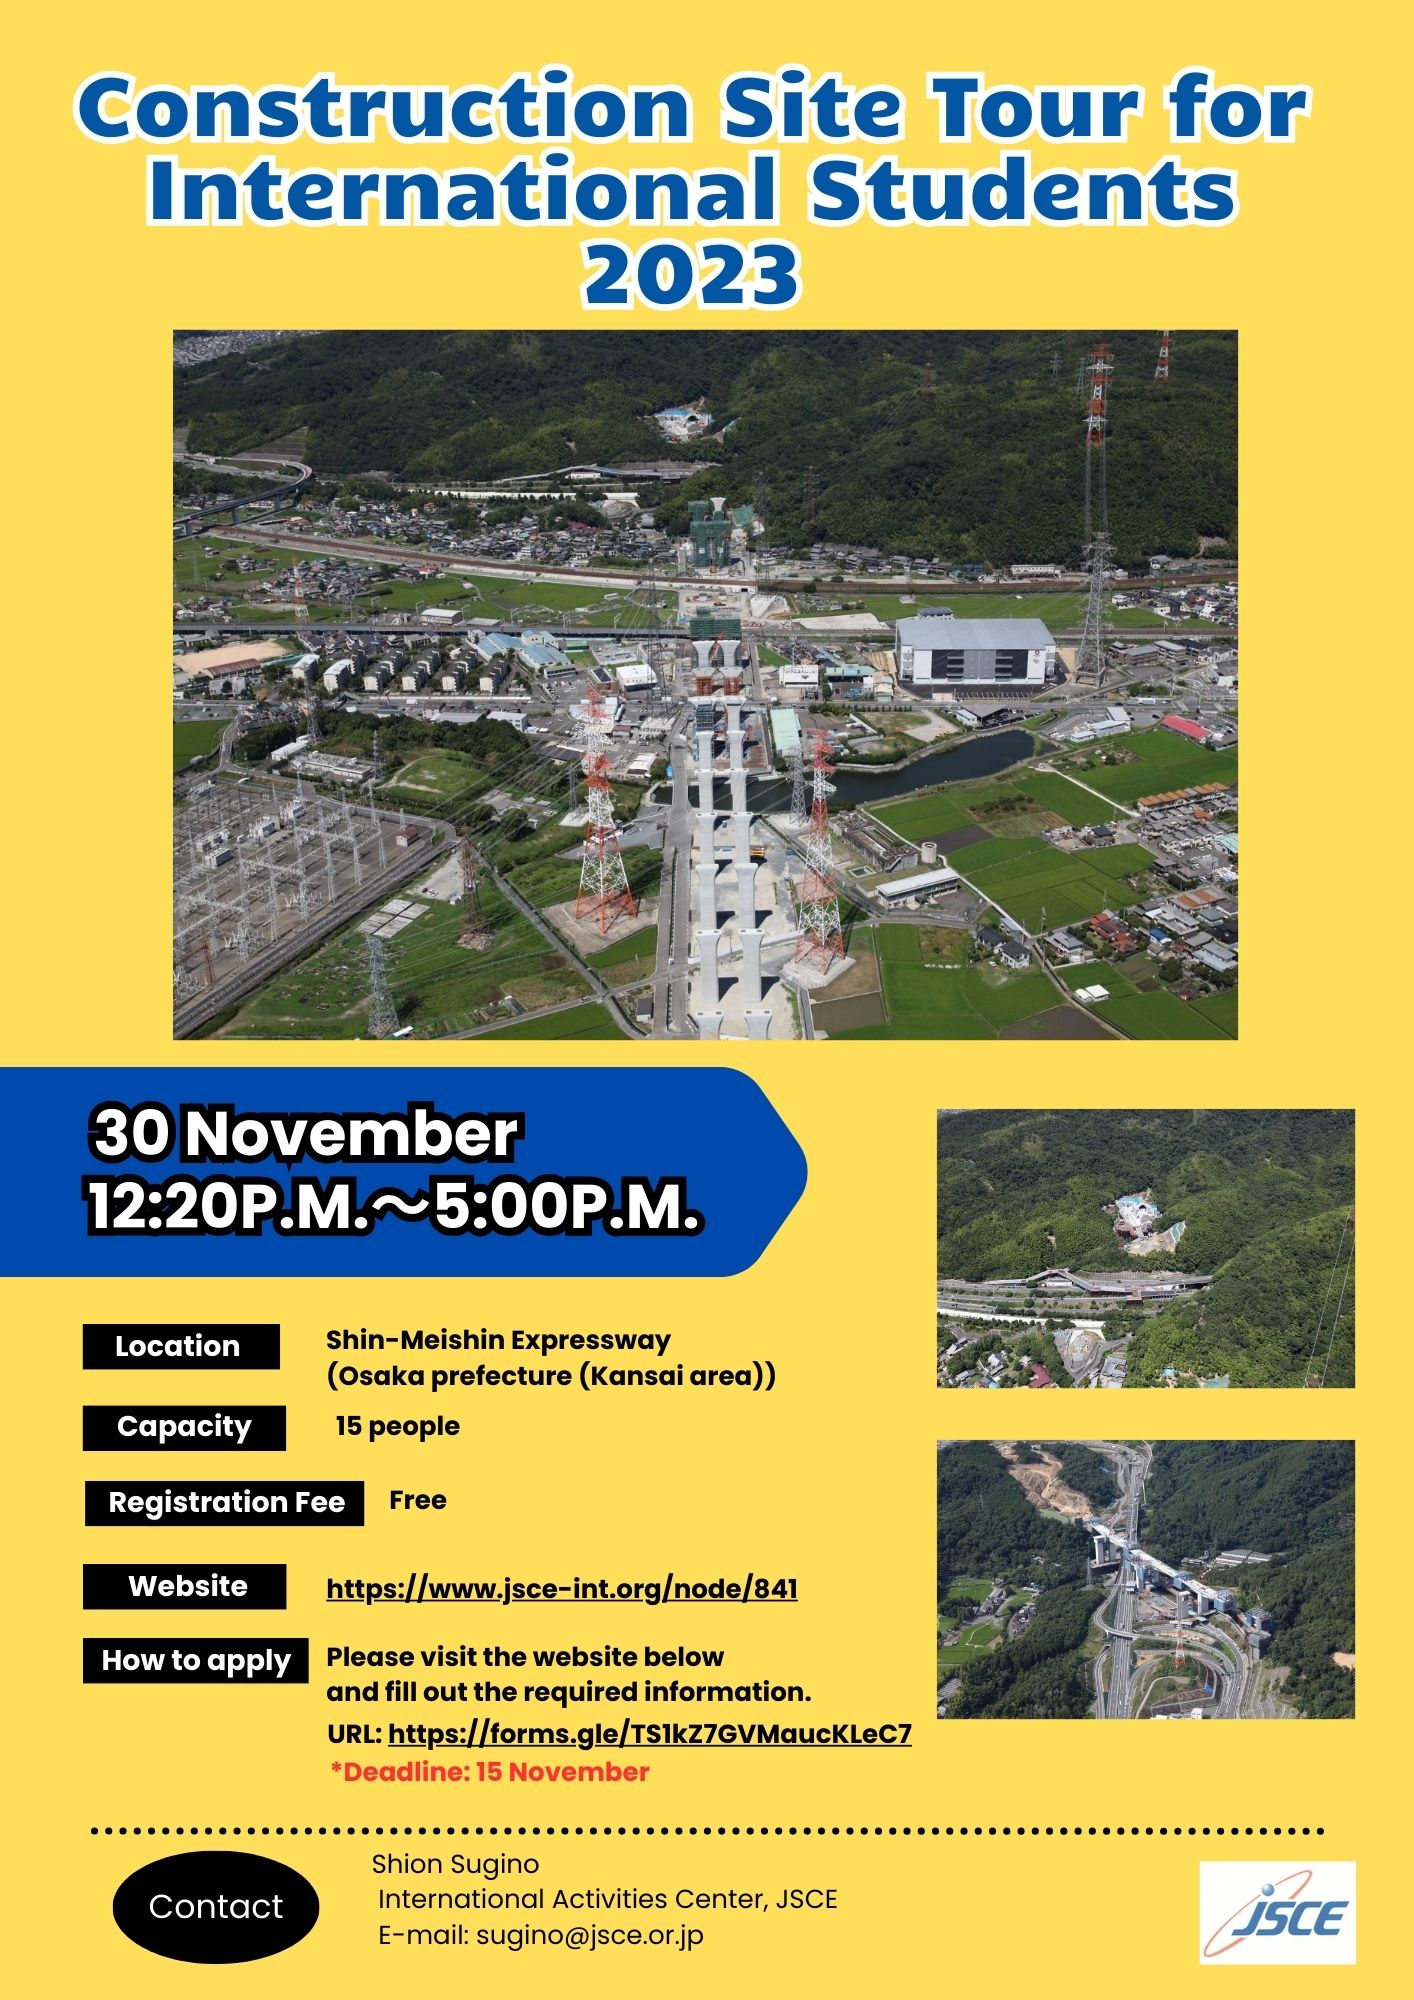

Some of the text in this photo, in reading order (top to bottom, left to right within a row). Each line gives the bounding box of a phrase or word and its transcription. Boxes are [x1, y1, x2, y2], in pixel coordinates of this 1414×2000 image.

[79, 69, 1307, 138] Construction Site Tour for
[152, 152, 1234, 221] International Students
[586, 244, 797, 305] 2023
[95, 1108, 518, 1156] 30 November
[116, 1332, 240, 1357] Location
[326, 1327, 672, 1357] Shin-Meishin Expressway
[327, 1360, 776, 1393] (Osaka prefecture (Kansai area))
[117, 1412, 253, 1444] Capacity
[336, 1415, 461, 1443] 15 people
[109, 1488, 346, 1521] Registration Fee
[390, 1490, 447, 1510] Free
[128, 1572, 248, 1597] Website
[325, 1572, 799, 1606] https://www.jsce-int.org/node/841
[102, 1648, 292, 1679] How to apply
[327, 1644, 725, 1667] Please visit the website below
[326, 1679, 812, 1709] and fill out the required information.
[328, 1717, 913, 1751] URL: https://forms.gle/TS1kZ7GVMaucKLeC7
[476, 1761, 503, 1782] 15
[509, 1761, 651, 1782] November
[372, 1852, 540, 1881] Shion Sugino
[149, 1894, 283, 1919] Contact
[379, 1887, 838, 1913] International Activities Center, JSCE
[1231, 1901, 1349, 1936] JSCE
[379, 1923, 704, 1952] E-mail: sugino@jsce.or.jp
